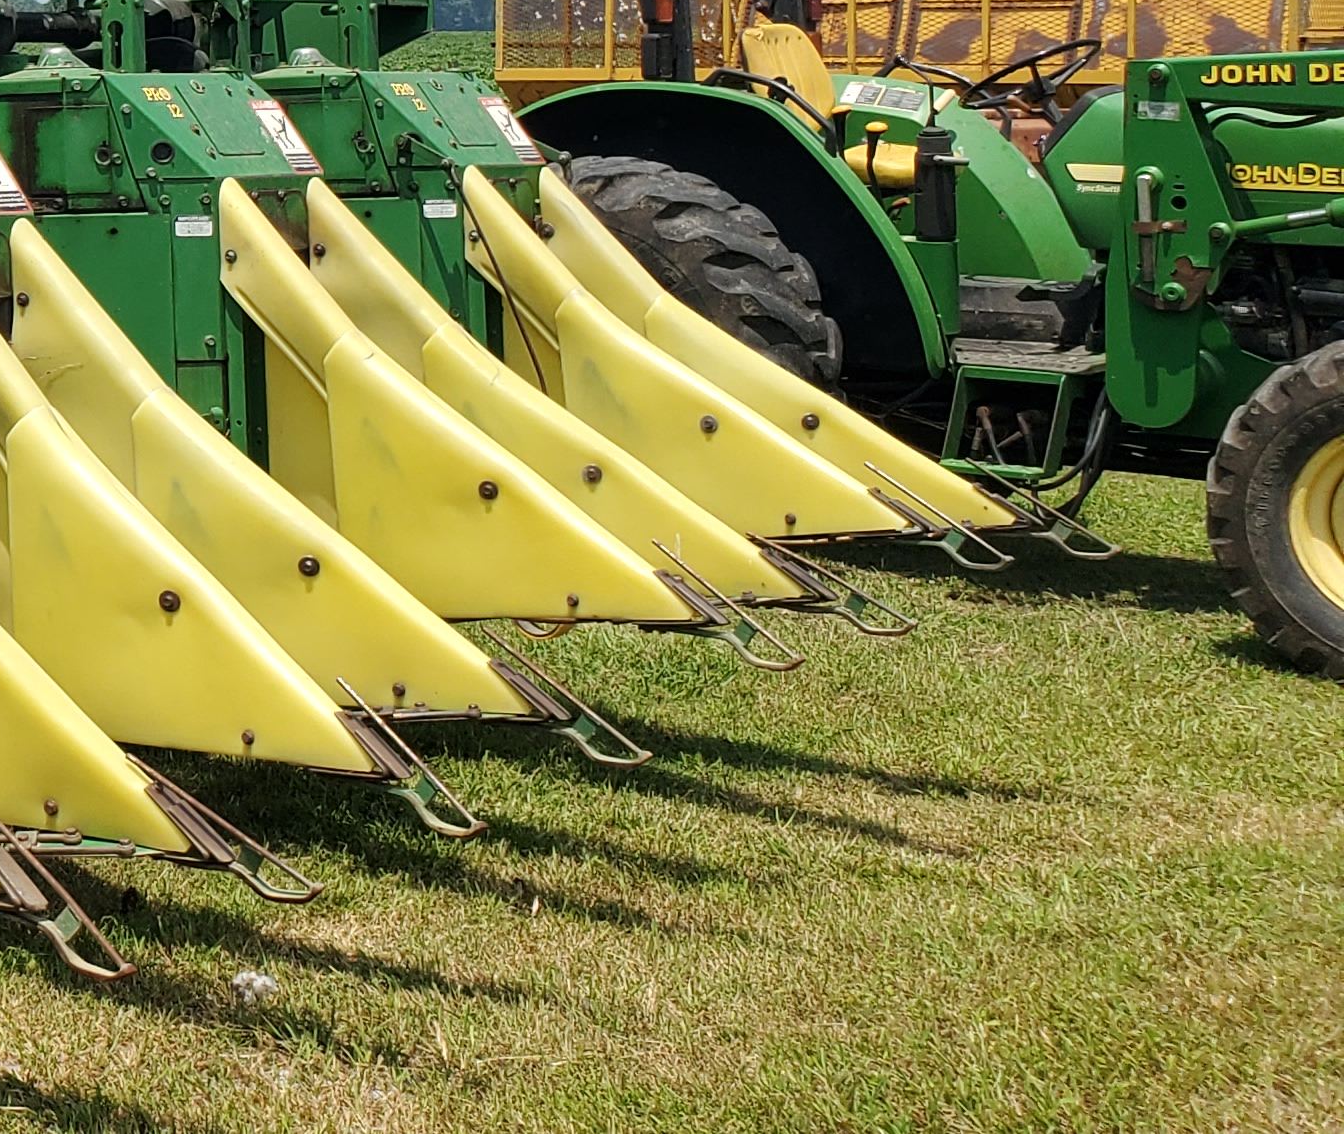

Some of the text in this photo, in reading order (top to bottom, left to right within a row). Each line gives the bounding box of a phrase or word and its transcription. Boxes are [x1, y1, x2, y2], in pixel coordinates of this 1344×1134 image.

[1200, 63, 1295, 86] JOHN
[141, 86, 172, 102] PRO
[166, 102, 185, 118] 12
[411, 97, 427, 111] 12
[1225, 162, 1294, 184] OHN
